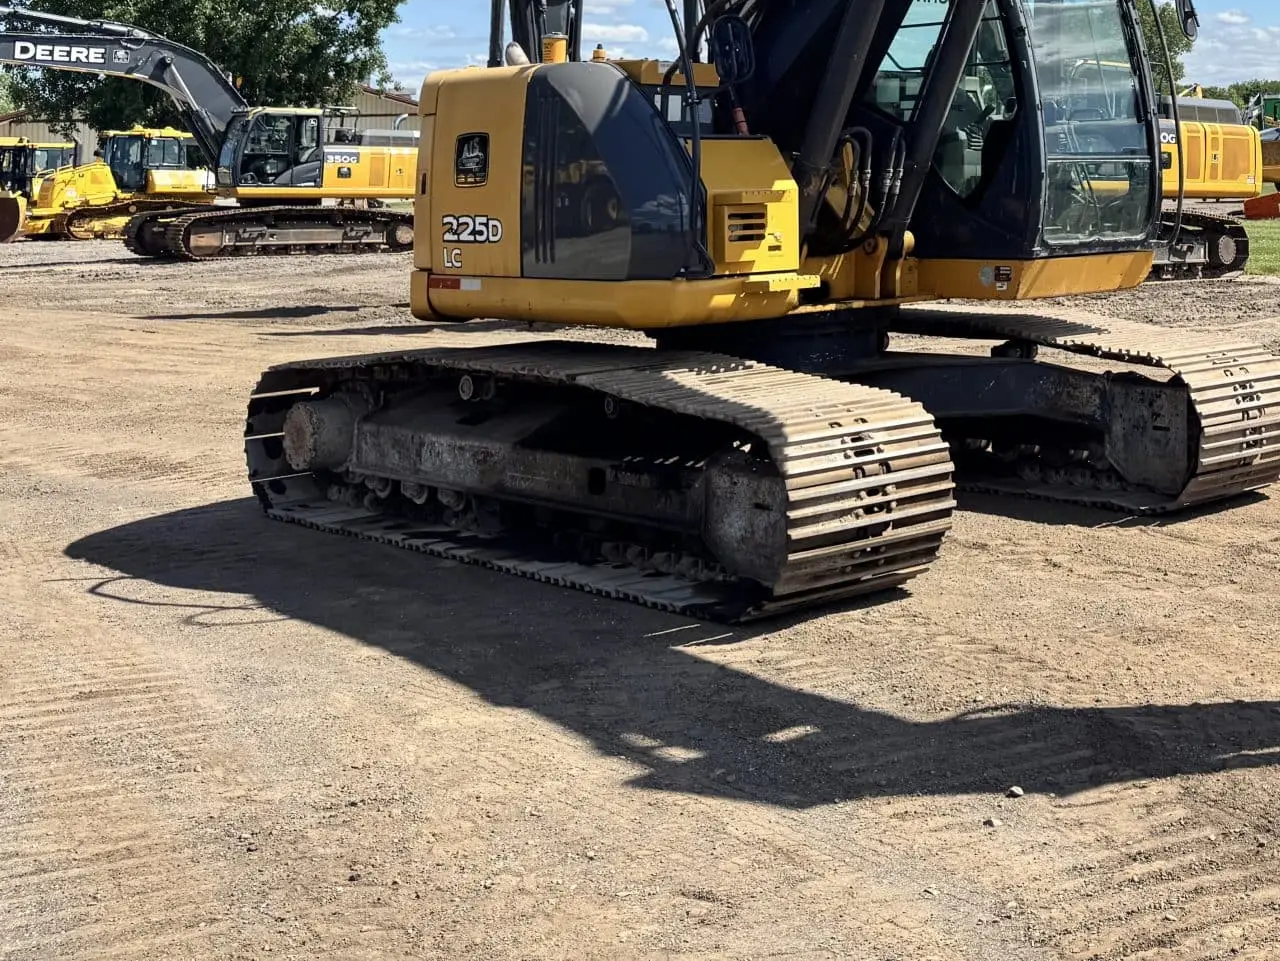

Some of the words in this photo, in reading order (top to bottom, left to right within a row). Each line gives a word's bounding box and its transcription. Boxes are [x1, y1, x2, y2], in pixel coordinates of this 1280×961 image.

[14, 41, 106, 64] DEERE
[1160, 131, 1176, 144] 0G
[326, 155, 358, 164] 350G
[442, 215, 503, 243] 225D
[443, 247, 463, 268] LC
